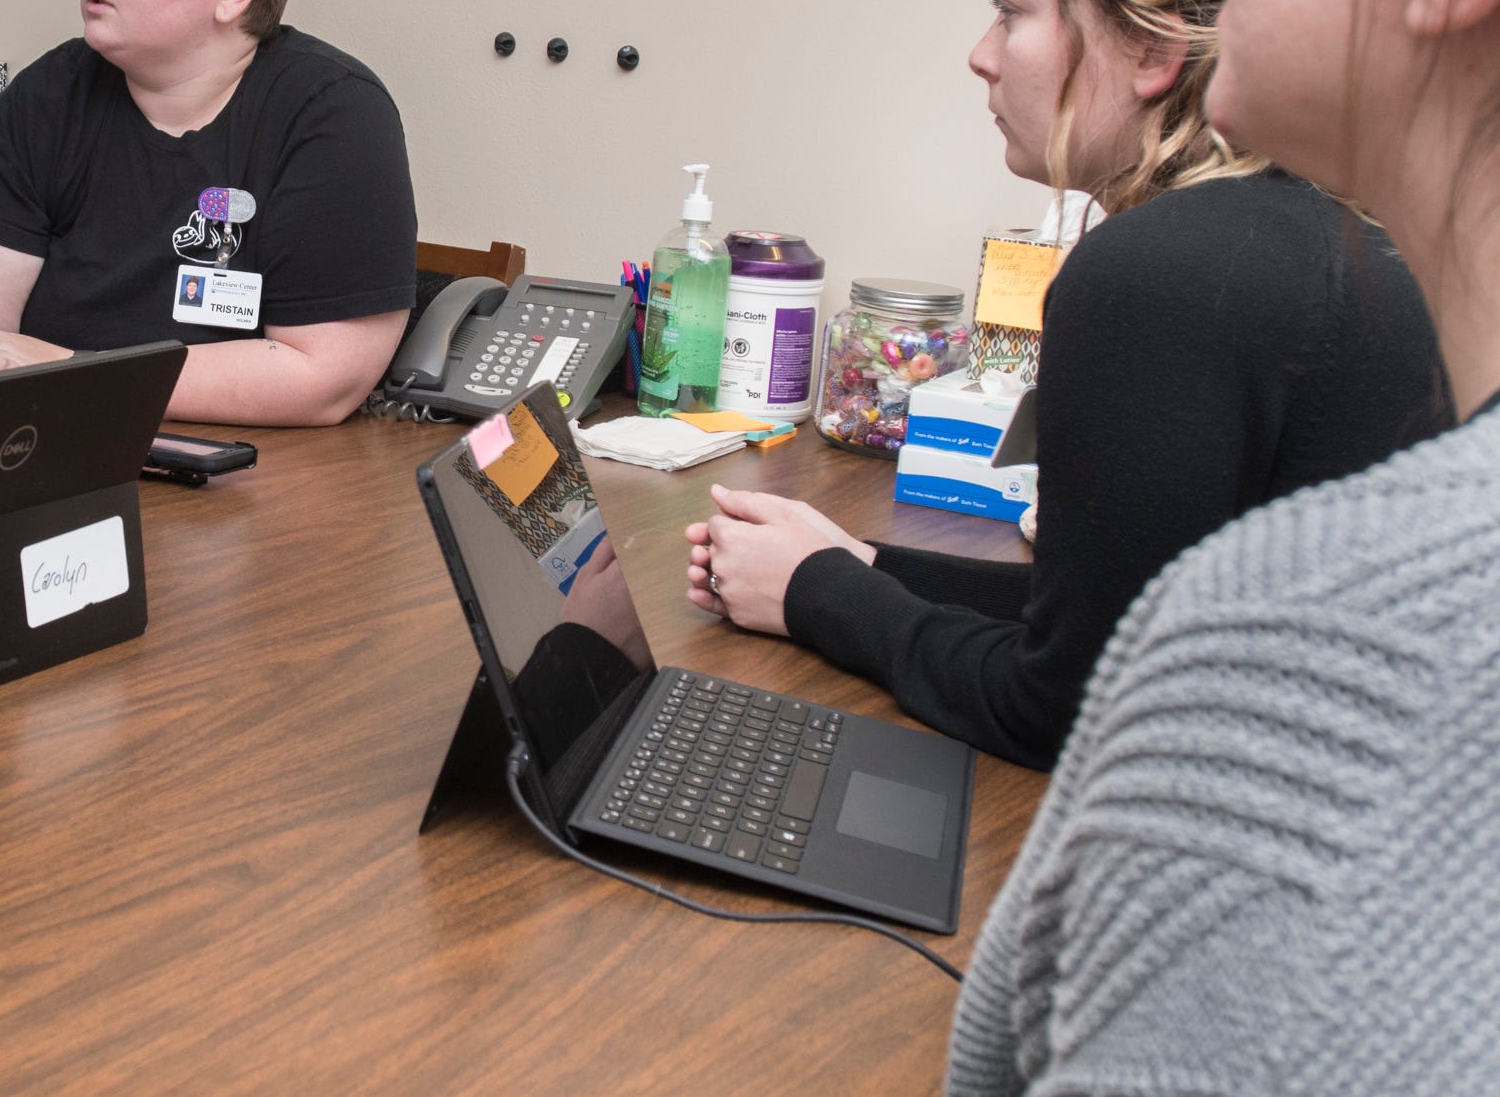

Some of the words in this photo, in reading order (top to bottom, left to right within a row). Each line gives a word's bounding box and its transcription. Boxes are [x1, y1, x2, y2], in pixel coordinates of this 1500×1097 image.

[212, 279, 238, 288] Lakeview
[239, 283, 257, 291] Center
[210, 303, 254, 316] TRISTAIN
[748, 391, 761, 399] PDI
[2, 440, 33, 456] DELL
[31, 554, 88, 595] Carolyn
